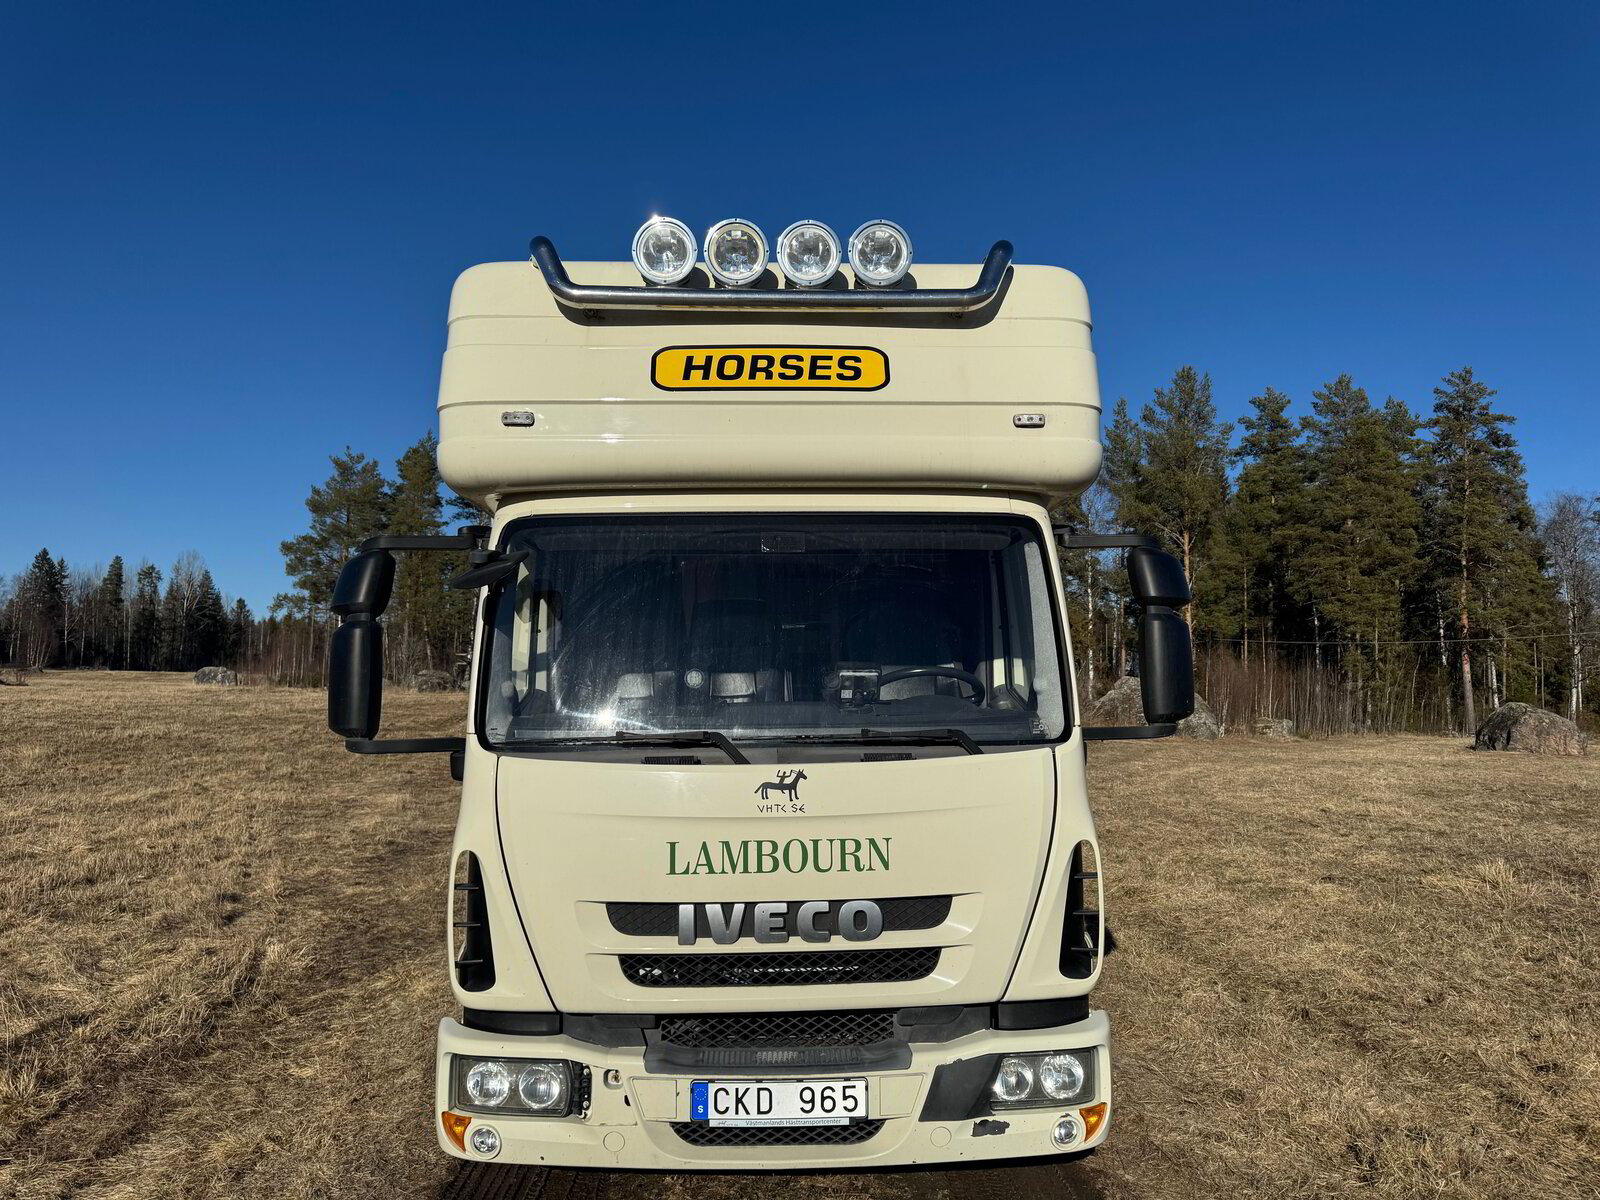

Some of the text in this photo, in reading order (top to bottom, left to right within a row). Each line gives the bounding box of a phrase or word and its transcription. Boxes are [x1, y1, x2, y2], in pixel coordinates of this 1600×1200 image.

[682, 354, 862, 381] HORSES
[665, 837, 892, 875] LAMBOURN
[678, 900, 884, 945] IVECO
[697, 1105, 704, 1114] S
[713, 1085, 859, 1115] CKD 965
